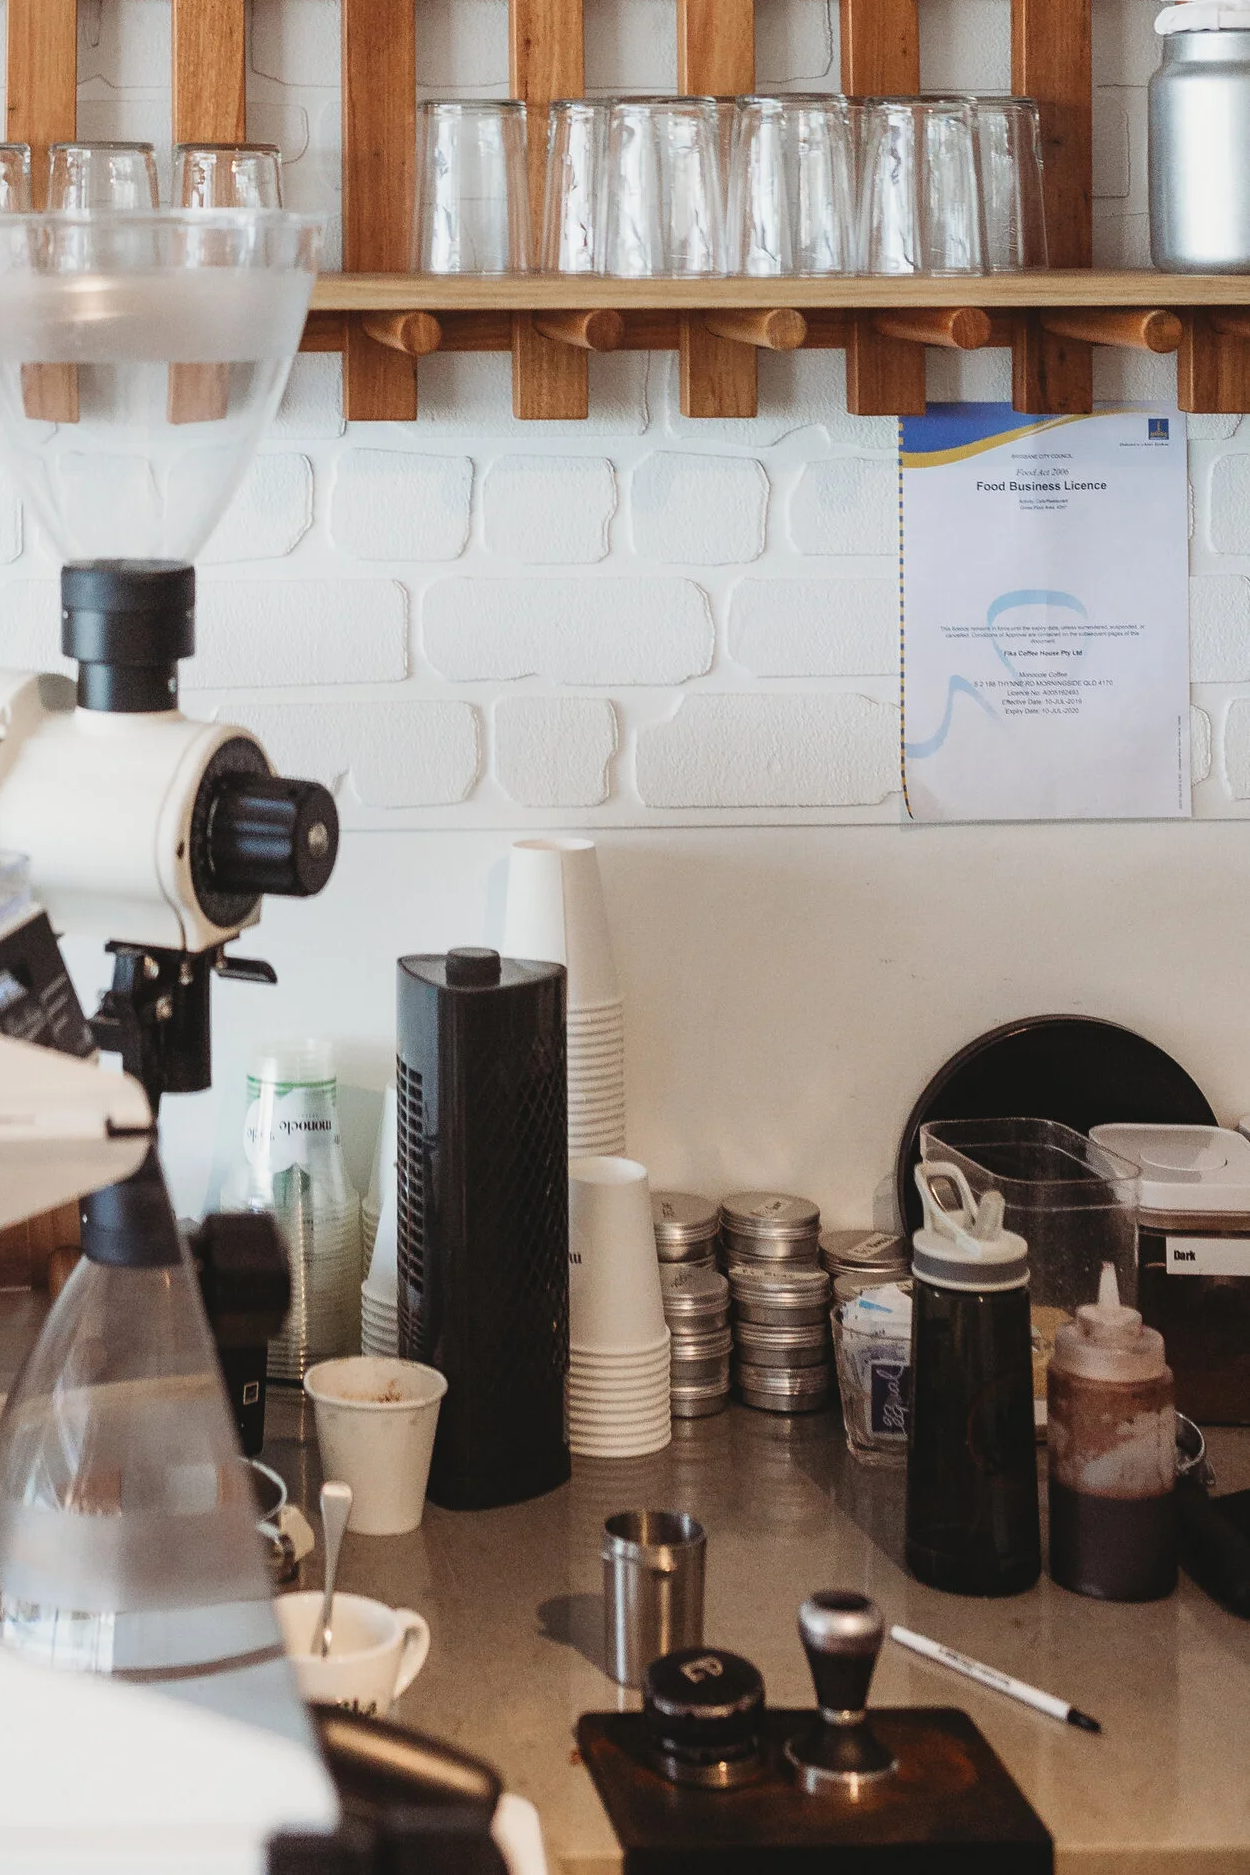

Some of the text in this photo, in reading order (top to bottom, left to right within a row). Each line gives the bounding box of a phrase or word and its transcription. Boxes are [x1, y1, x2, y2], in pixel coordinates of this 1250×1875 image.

[1016, 467, 1070, 476] Food Act 2006
[976, 481, 1107, 491] Food Business Licence
[278, 1120, 332, 1136] monocle
[1174, 1250, 1196, 1261] Dark
